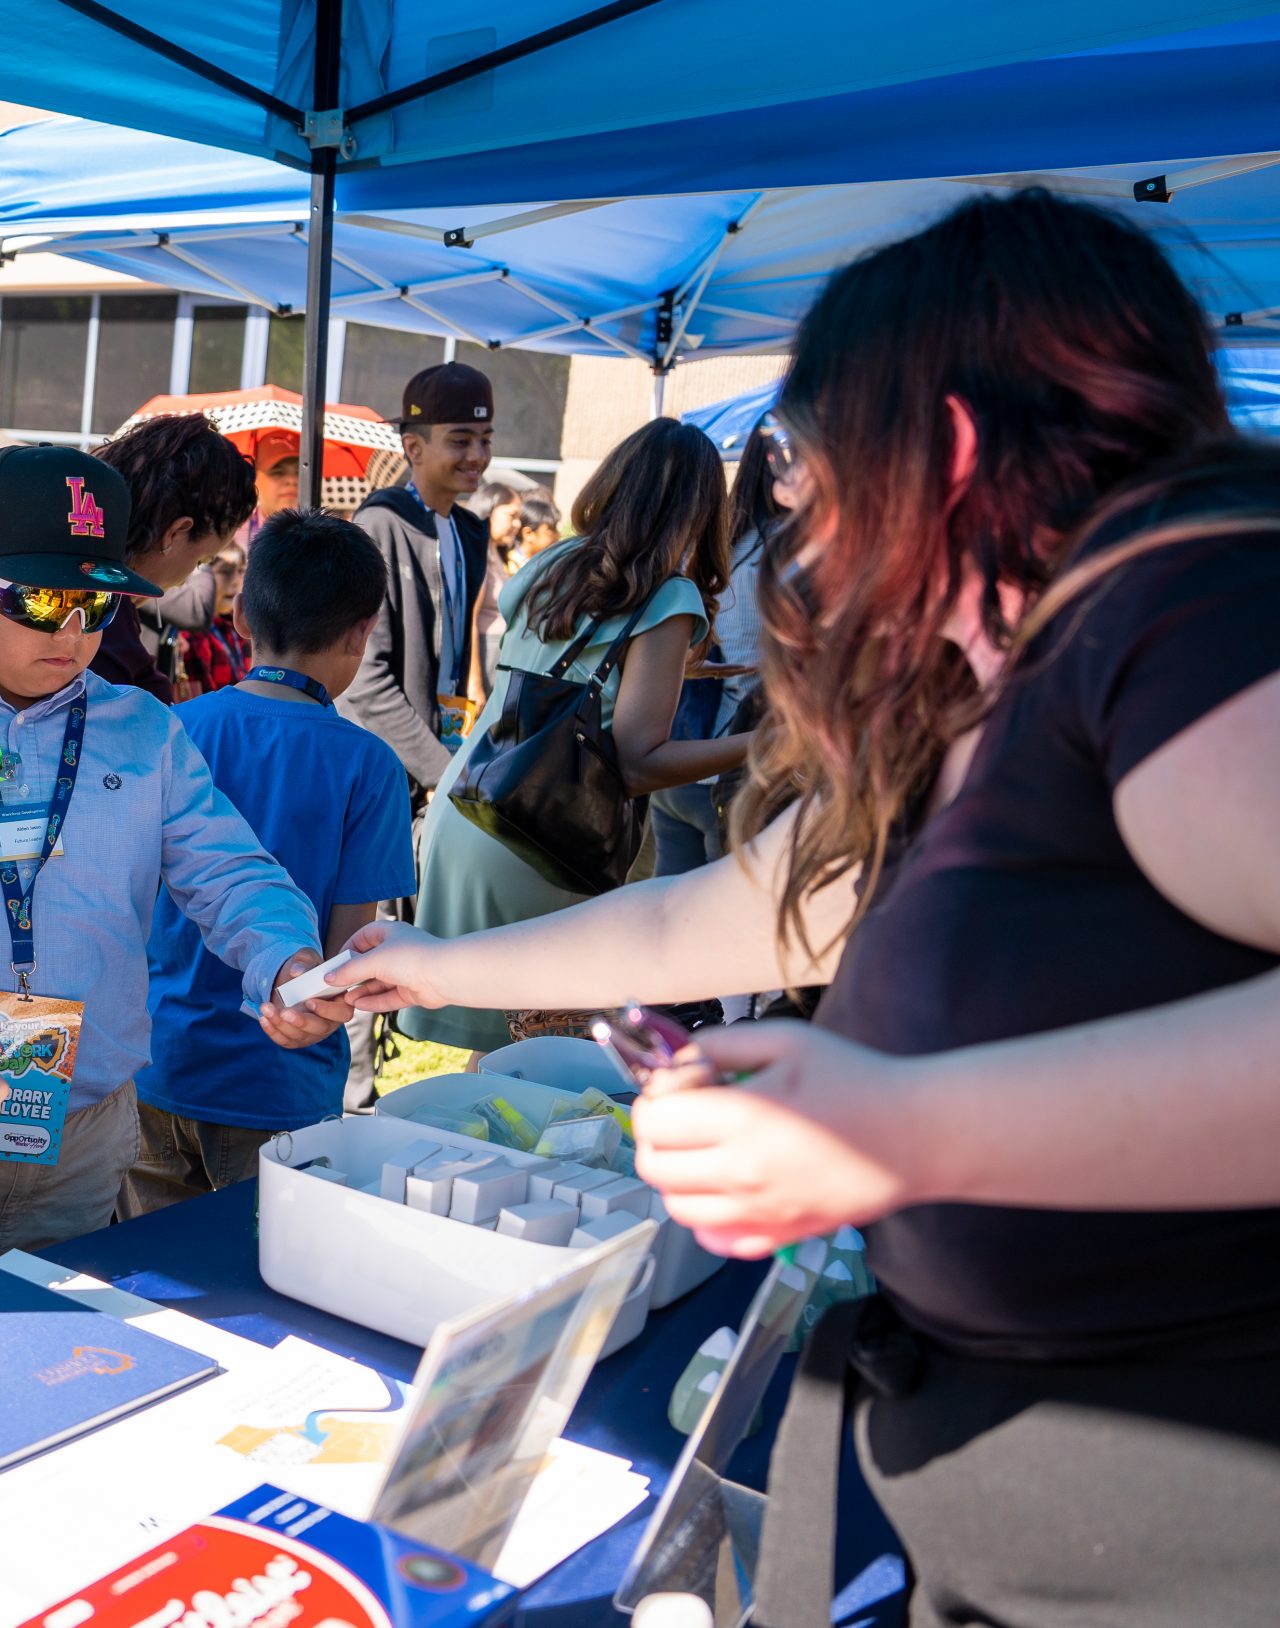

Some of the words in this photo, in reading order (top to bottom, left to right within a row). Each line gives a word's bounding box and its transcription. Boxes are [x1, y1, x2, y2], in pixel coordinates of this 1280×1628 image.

[65, 476, 105, 538] LA
[15, 1021, 41, 1033] your
[4, 1087, 54, 1105] ORARY
[0, 1101, 52, 1120] LOYEE
